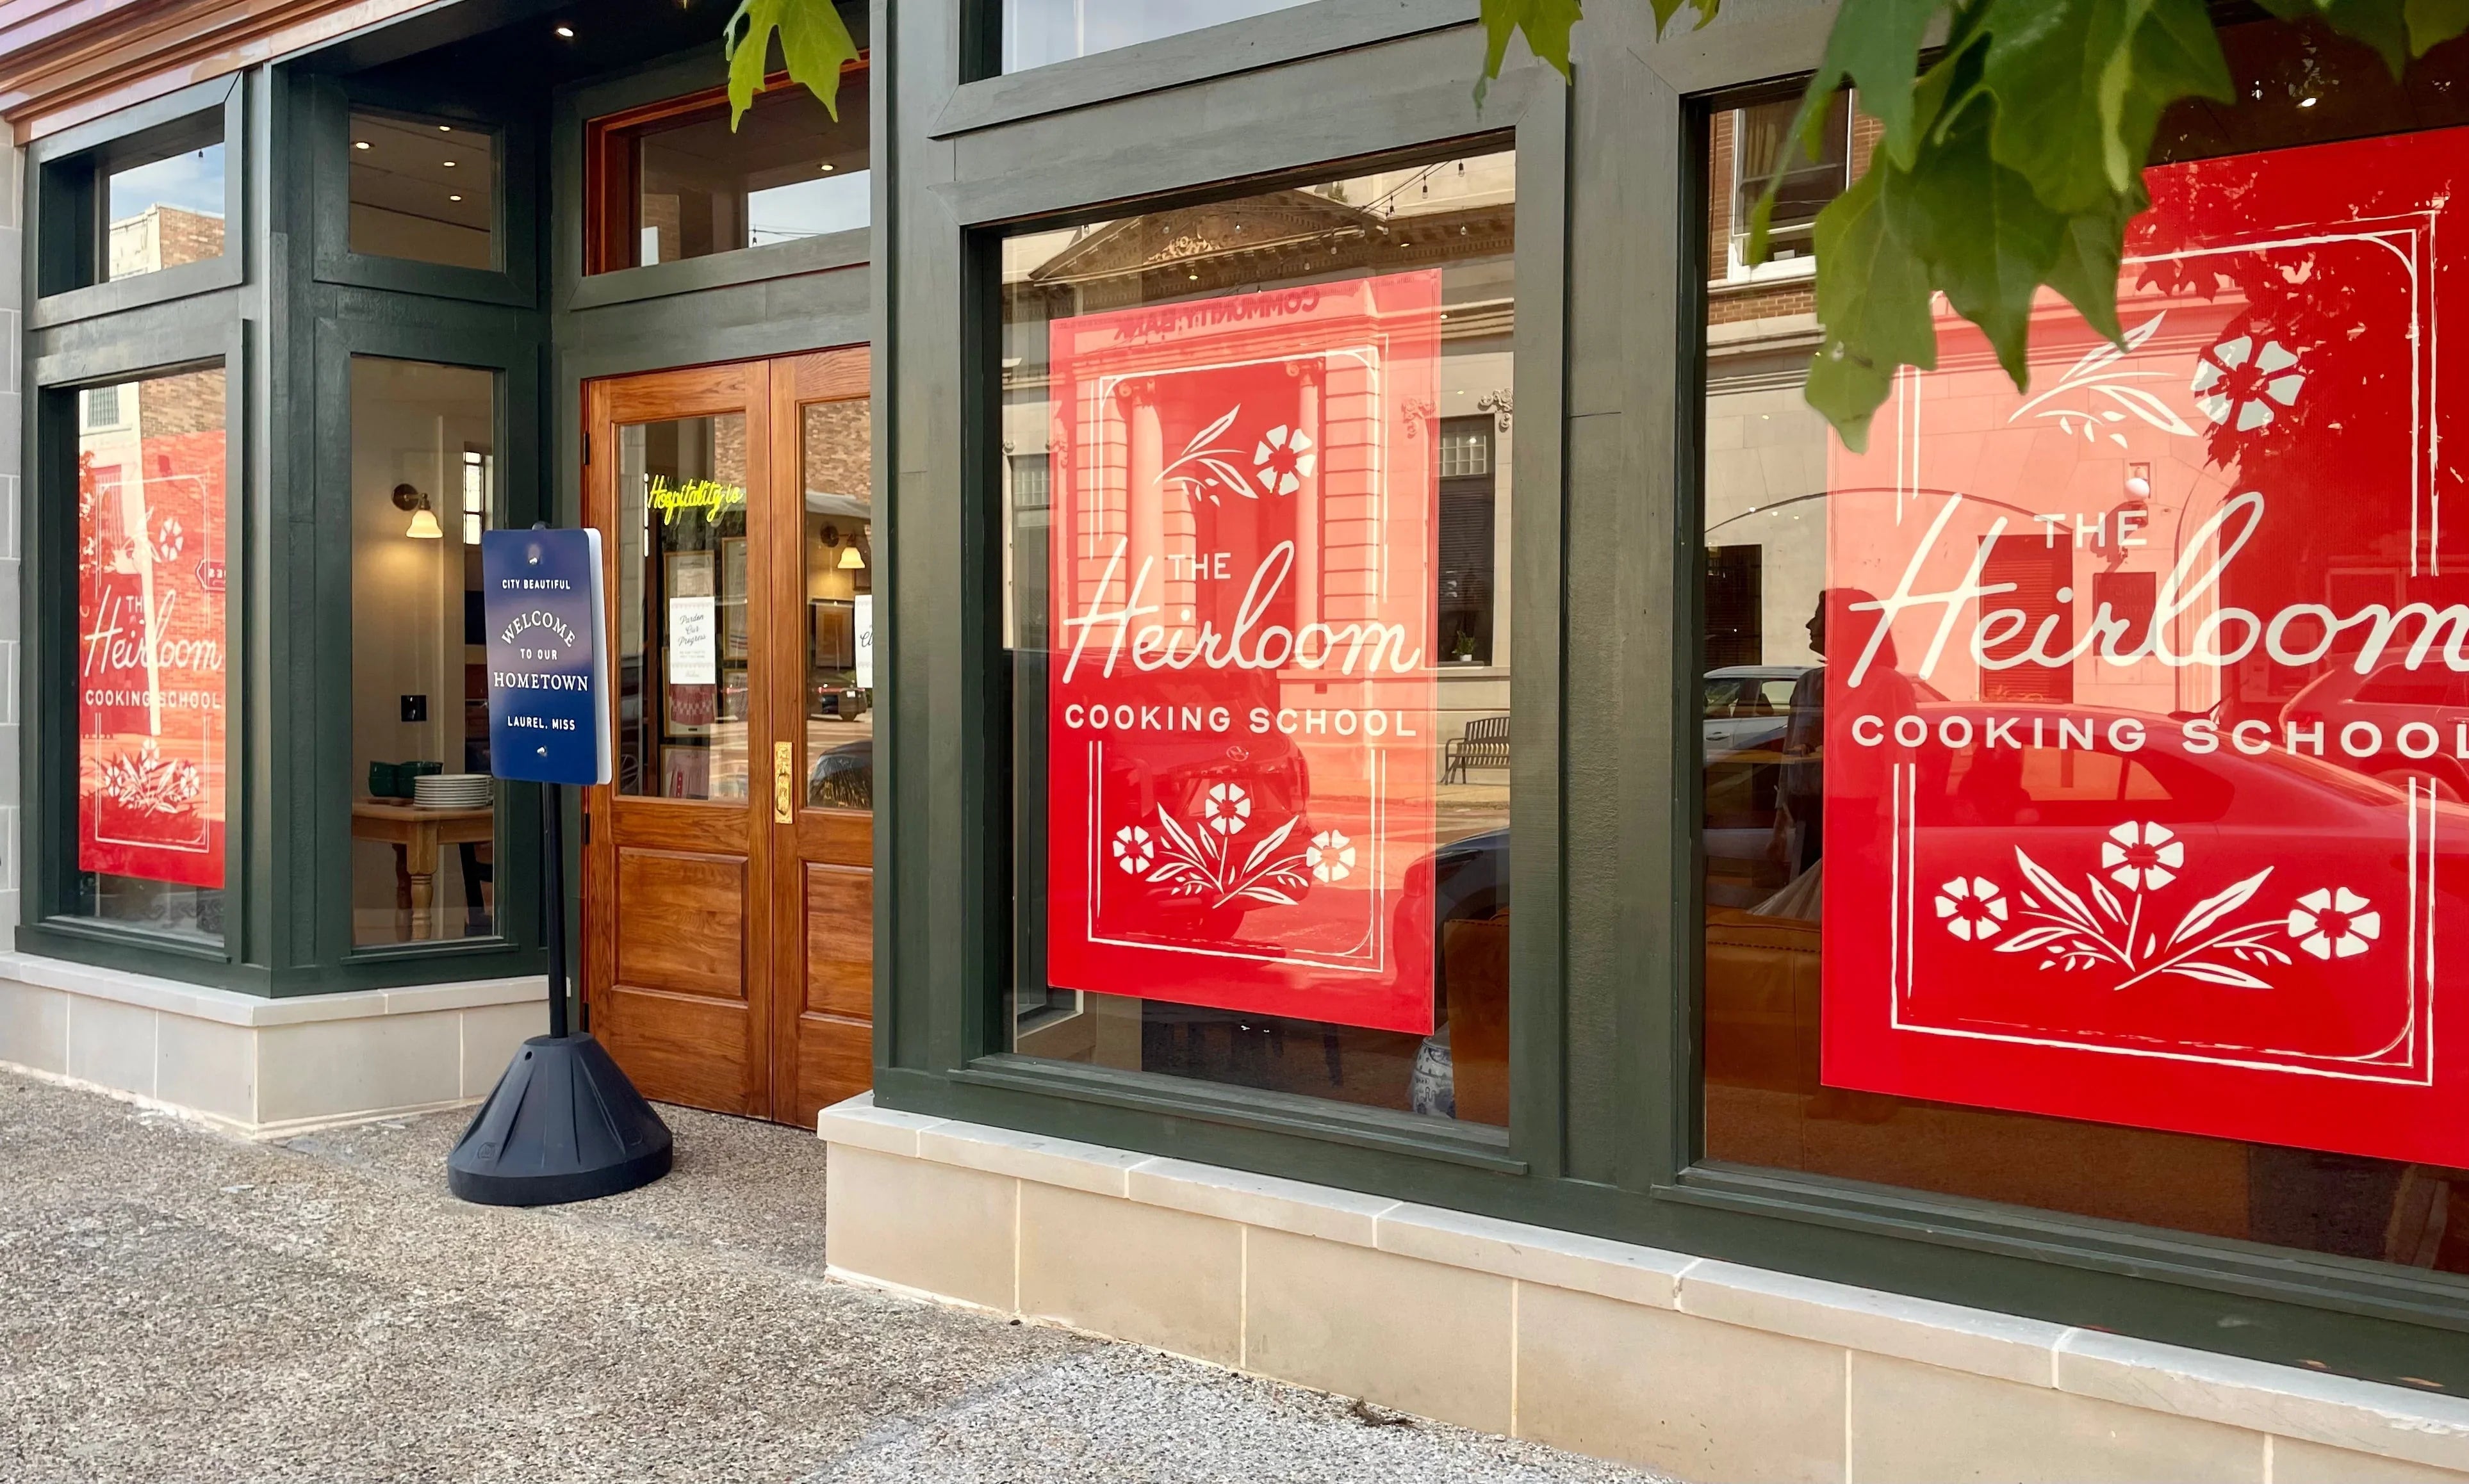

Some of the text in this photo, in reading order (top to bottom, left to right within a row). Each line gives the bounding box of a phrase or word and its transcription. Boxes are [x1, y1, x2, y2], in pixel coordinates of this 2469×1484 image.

[647, 474, 744, 526] Hospitality is
[2033, 510, 2148, 549] THE
[1167, 552, 1231, 580] THE
[502, 579, 571, 591] CITY BEAUTIFUL
[1848, 491, 2469, 689] Heirloom
[126, 596, 150, 613] TH
[1062, 536, 1421, 684] Heirloom
[84, 583, 222, 678] Heirloom
[501, 610, 576, 648] WELCOME
[520, 648, 558, 660] TO OUR
[493, 671, 588, 691] HOMETOWN
[85, 689, 221, 709] COOKING SCHOOL
[552, 719, 575, 731] MISS
[1065, 703, 1416, 737] COOKING SCHOOL
[1851, 714, 2147, 751] COOKING
